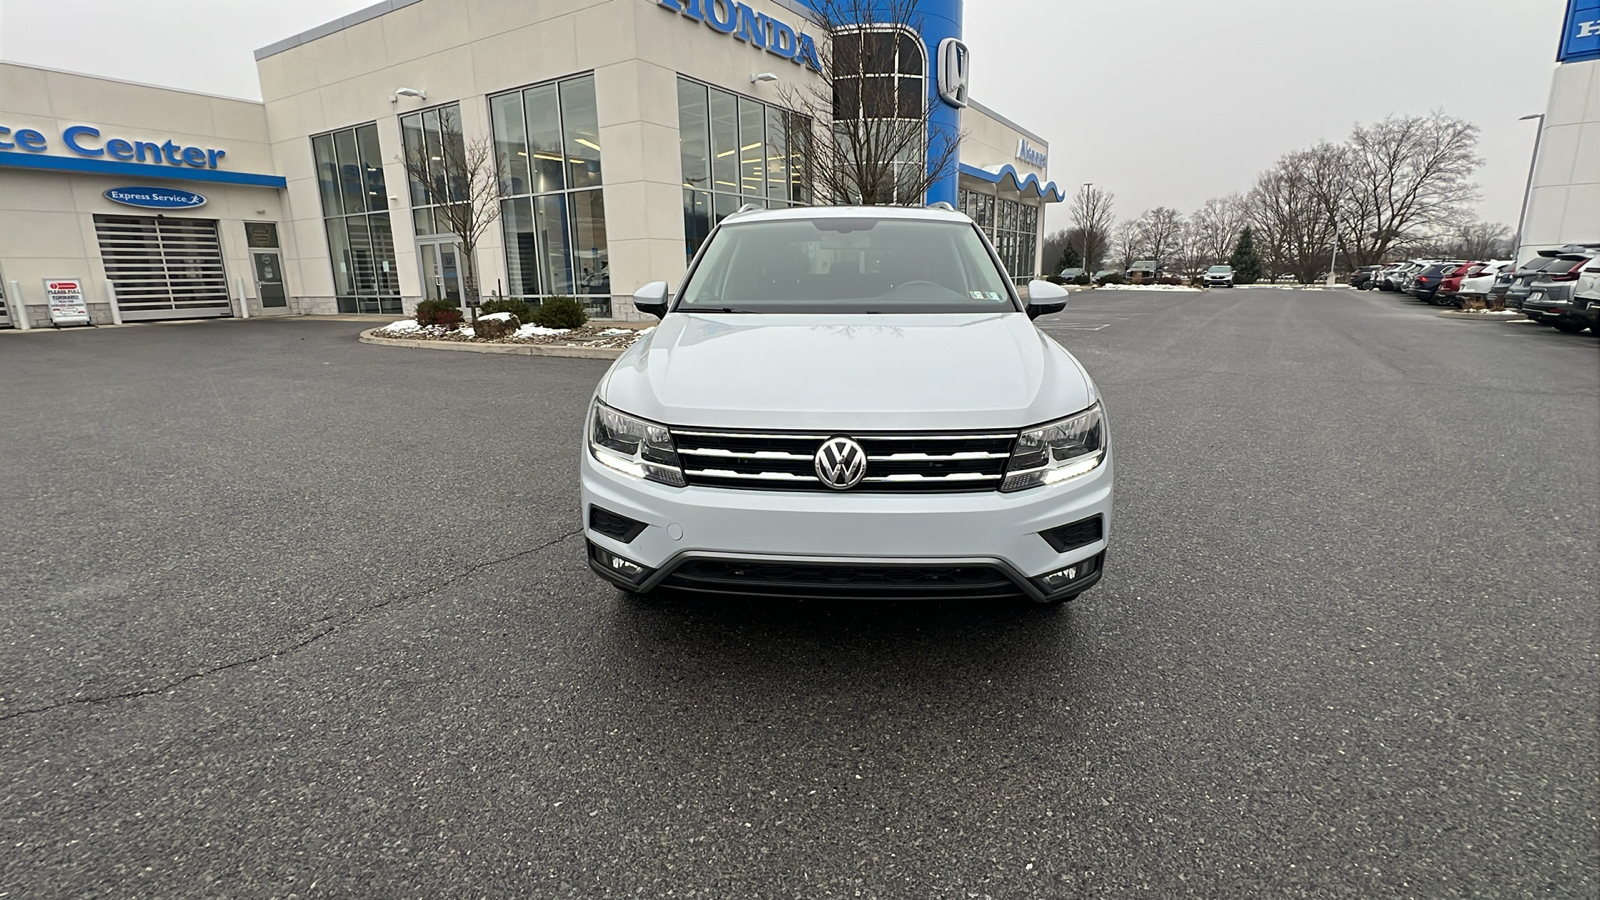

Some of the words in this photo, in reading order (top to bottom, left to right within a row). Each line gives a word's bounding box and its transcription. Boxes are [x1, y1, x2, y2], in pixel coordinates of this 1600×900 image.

[62, 125, 226, 169] Center
[111, 190, 150, 201] Express
[152, 193, 187, 203] Service
